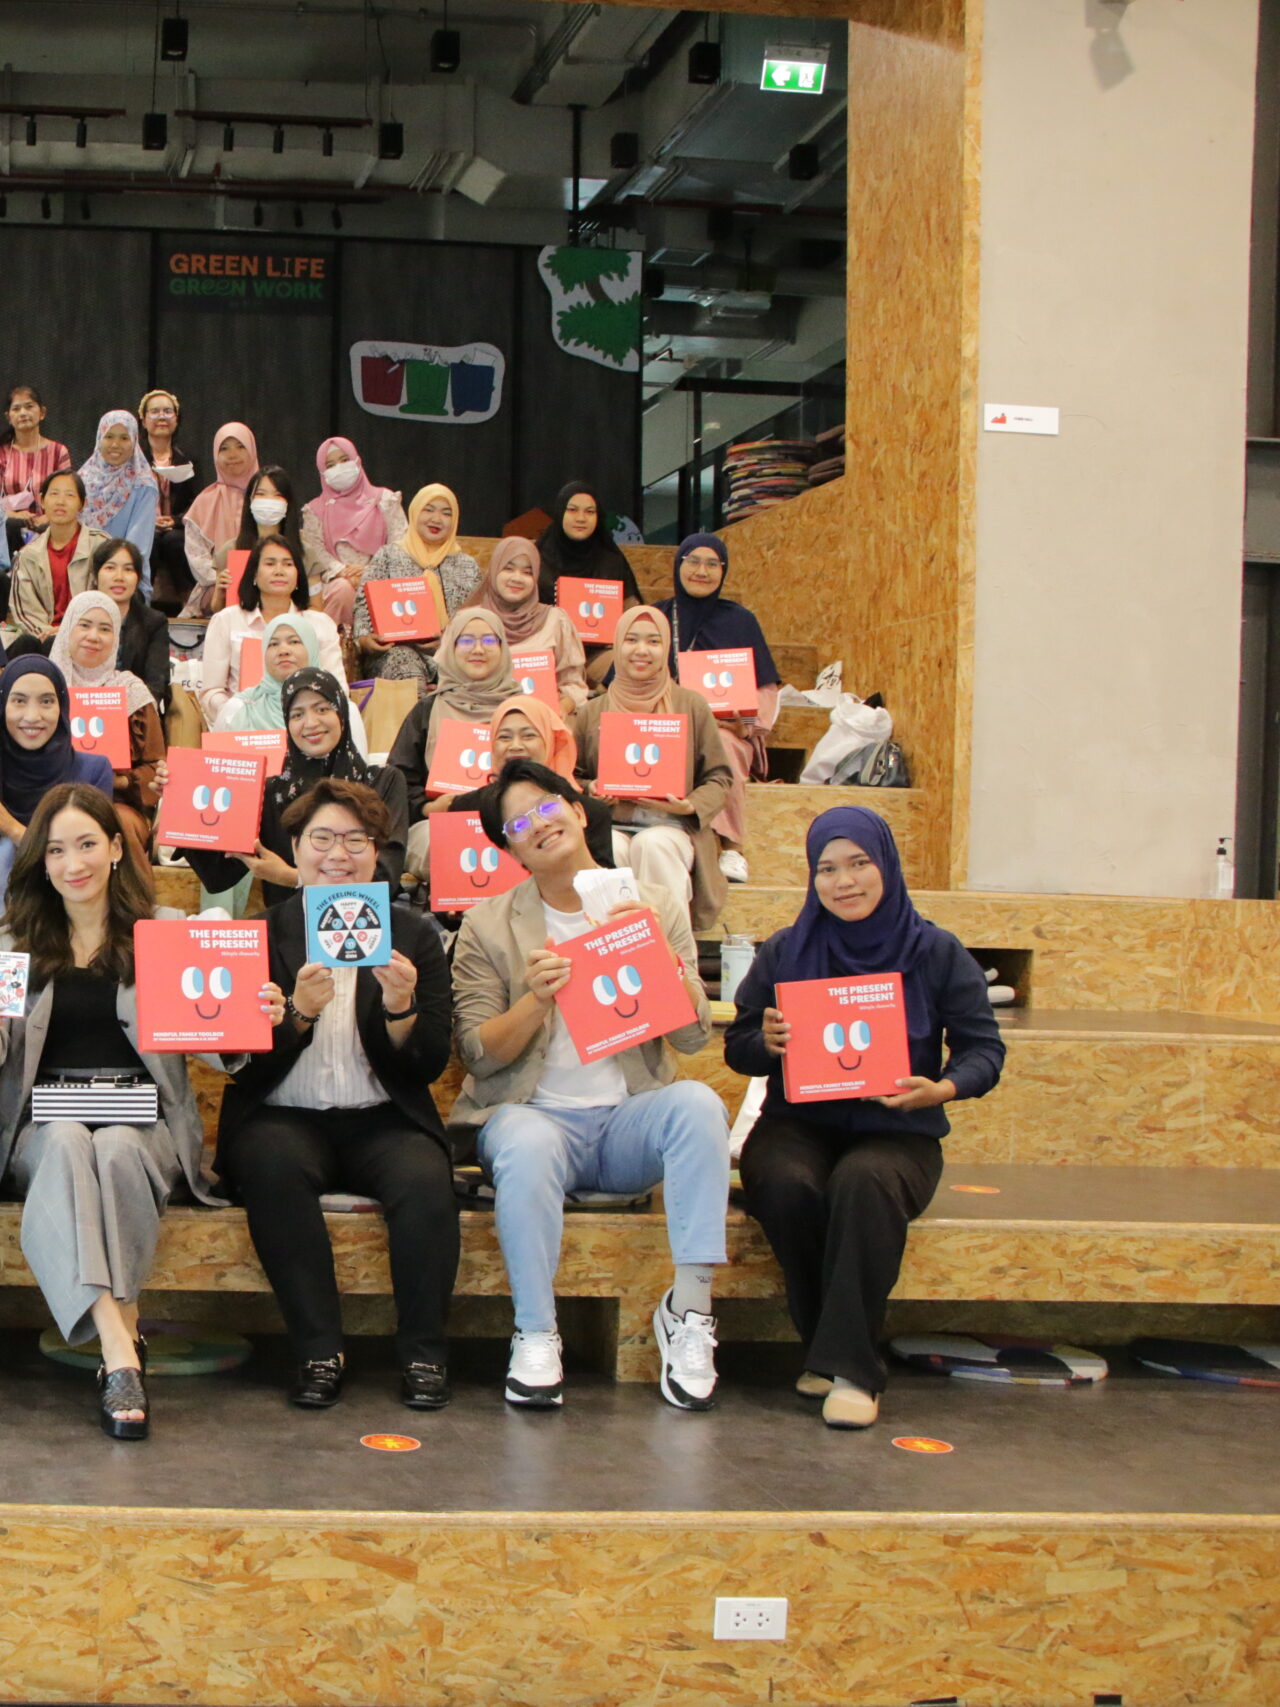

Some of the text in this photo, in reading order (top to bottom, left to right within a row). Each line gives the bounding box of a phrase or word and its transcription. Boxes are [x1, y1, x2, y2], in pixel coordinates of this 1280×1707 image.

[169, 253, 325, 278] GREEN LIFE
[253, 280, 323, 299] WORK
[221, 759, 258, 768] PRESENT
[221, 767, 256, 776] PRESENT
[316, 891, 381, 911] THE FEELING WHEEL
[190, 930, 259, 939] THE PRESENT
[585, 936, 605, 951] THE
[606, 920, 648, 942] PRESENT
[212, 941, 259, 949] PRESENT
[598, 944, 607, 955] IS
[609, 929, 652, 951] PRESENT
[828, 983, 894, 996] THE PRESENT
[839, 993, 894, 1005] IS PRESENT
